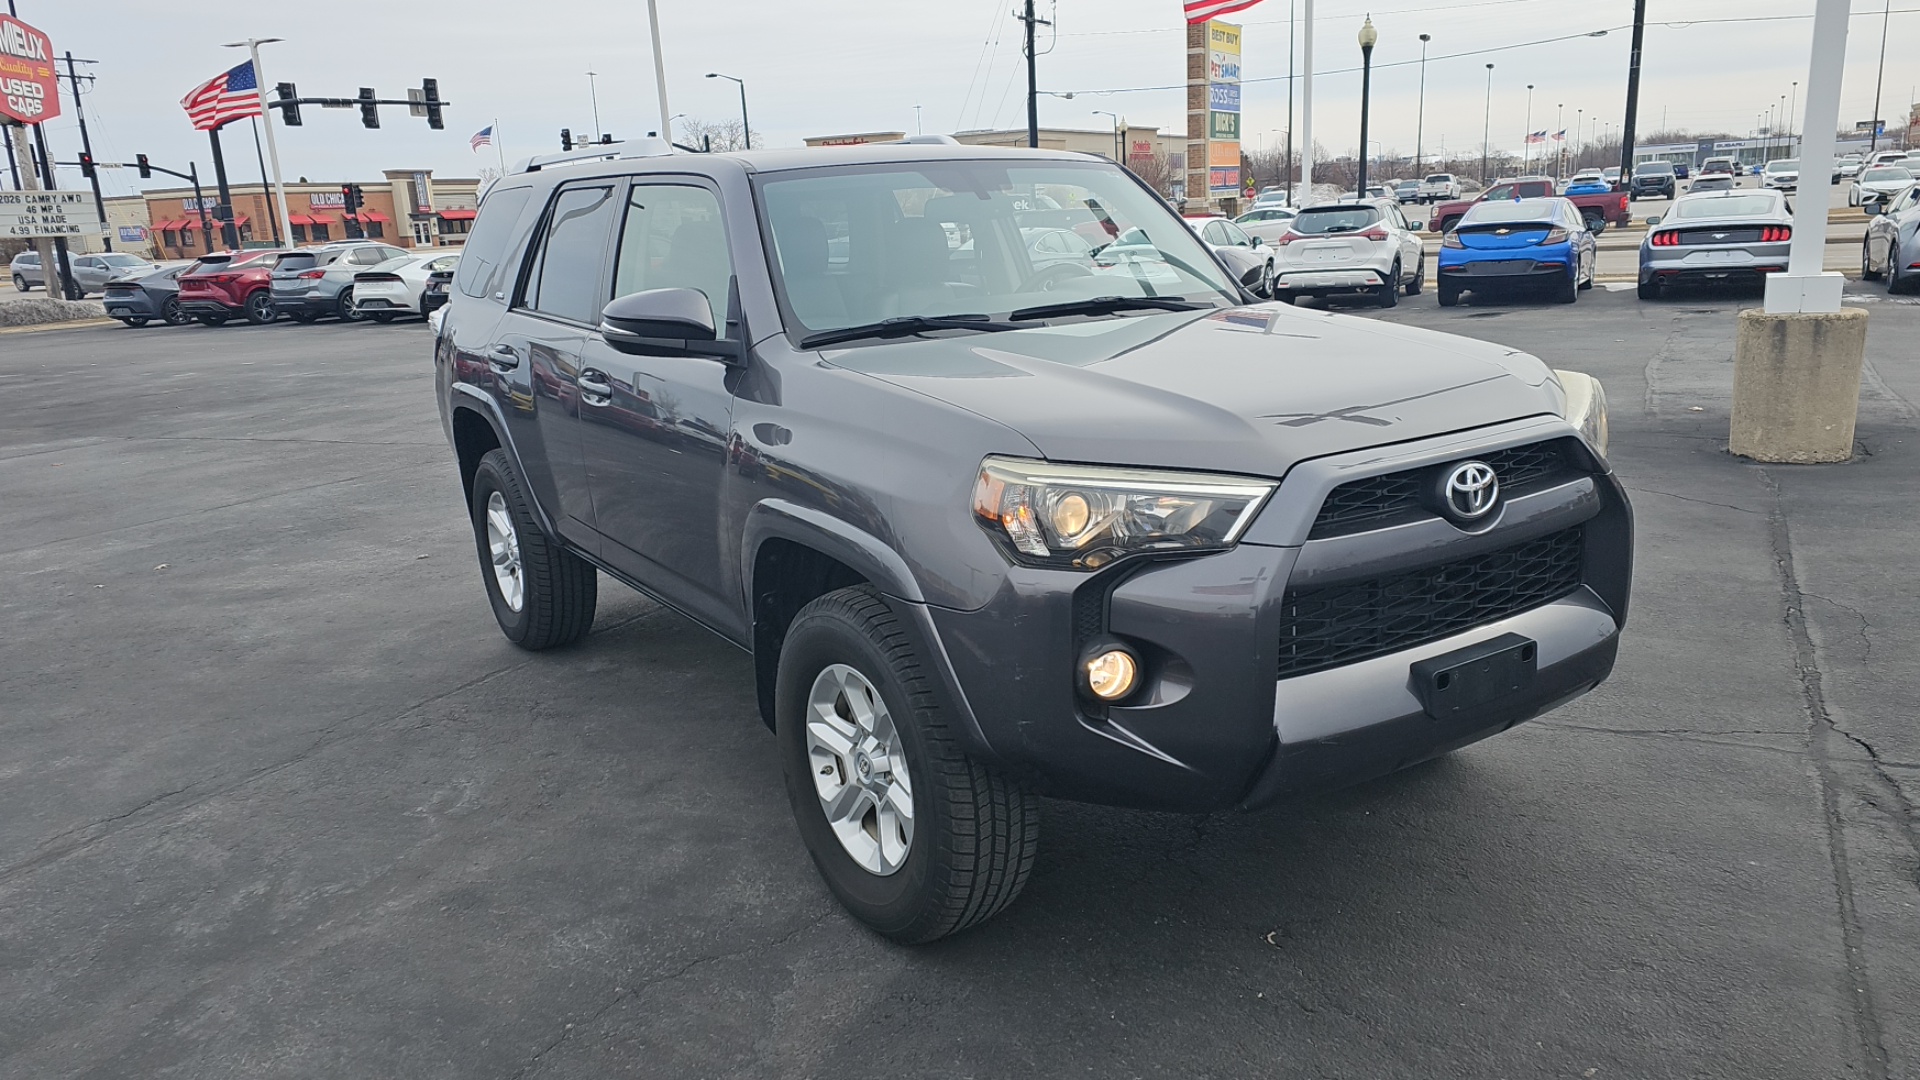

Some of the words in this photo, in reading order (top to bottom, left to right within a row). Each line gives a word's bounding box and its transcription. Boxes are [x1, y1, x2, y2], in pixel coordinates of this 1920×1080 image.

[1212, 28, 1225, 43] BEST
[1226, 31, 1239, 45] BUY
[0, 77, 44, 99] USED
[8, 94, 43, 117] CARS
[1215, 112, 1235, 132] DICK'S
[0, 195, 21, 204] 2026
[25, 194, 57, 204] CAMRY
[310, 192, 325, 205] OLD
[25, 205, 37, 214] 46
[18, 216, 37, 224] USA
[42, 215, 67, 224] MADE
[10, 226, 30, 235] 4.99
[34, 225, 80, 234] FINANCING
